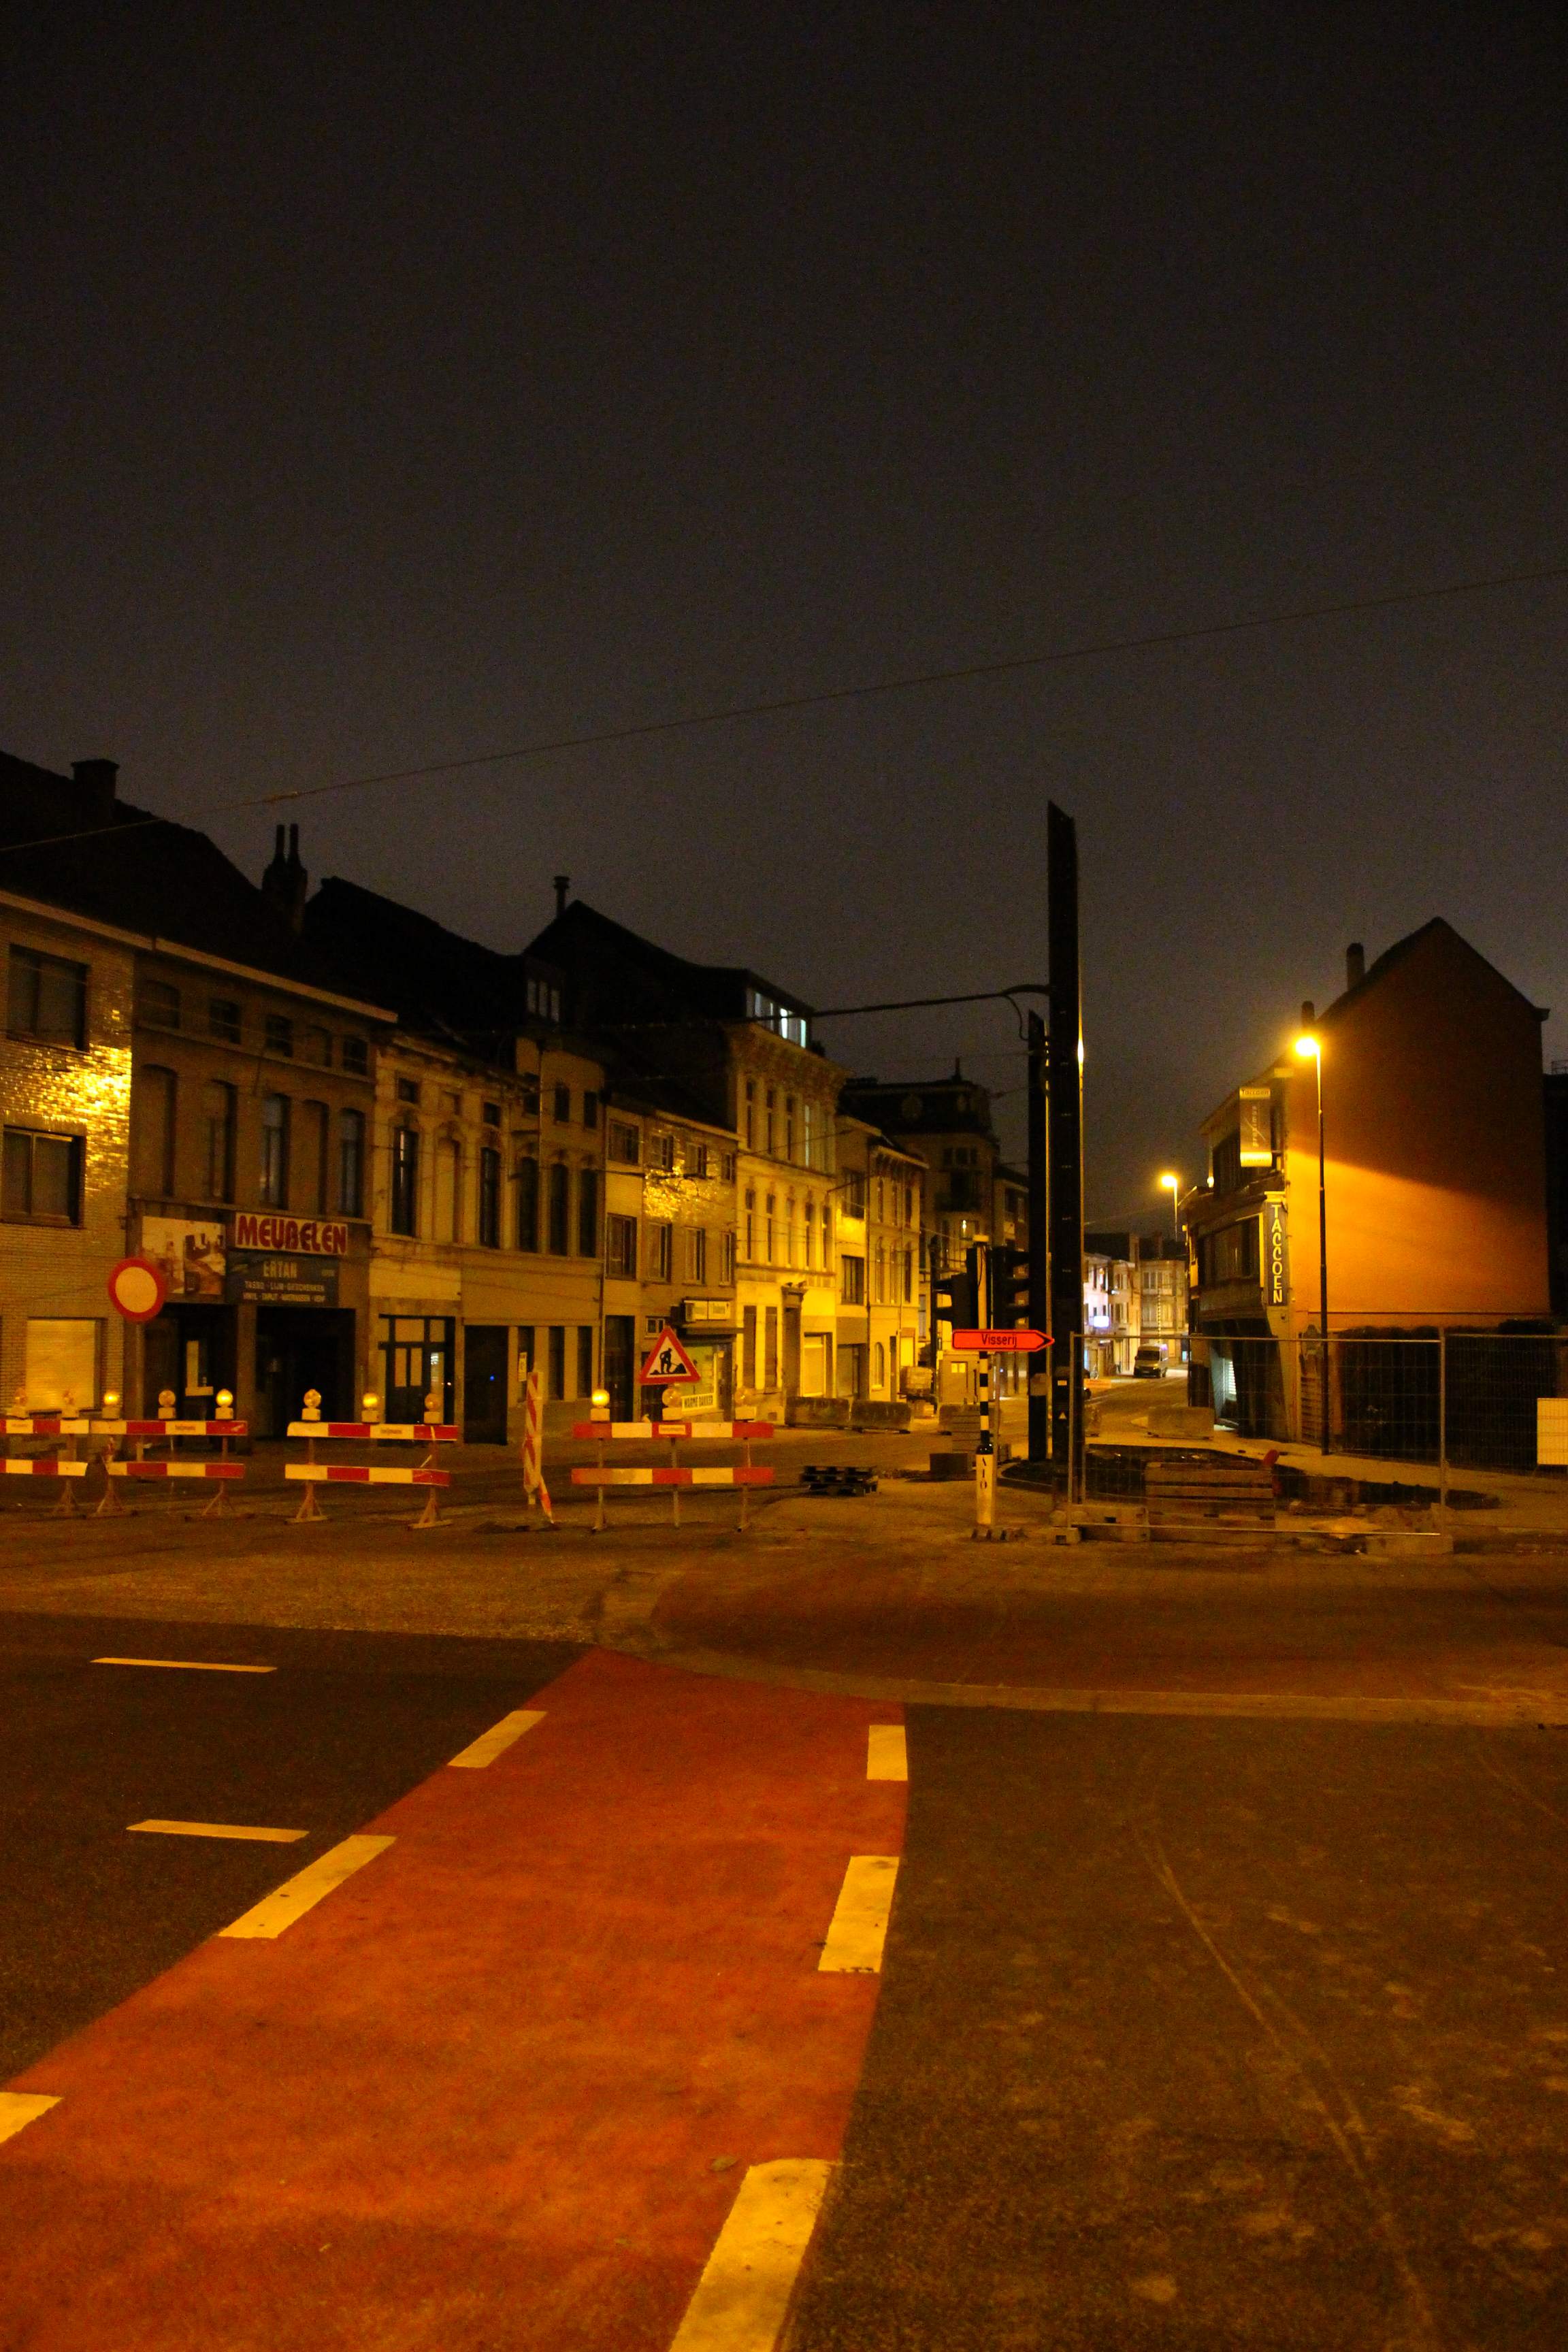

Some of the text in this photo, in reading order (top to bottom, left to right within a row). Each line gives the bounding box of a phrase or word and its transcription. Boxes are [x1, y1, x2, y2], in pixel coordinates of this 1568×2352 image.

[238, 1215, 346, 1254] MEUBELEN
[1271, 1205, 1283, 1303] TACCOEN
[981, 1333, 1017, 1348] Visserij
